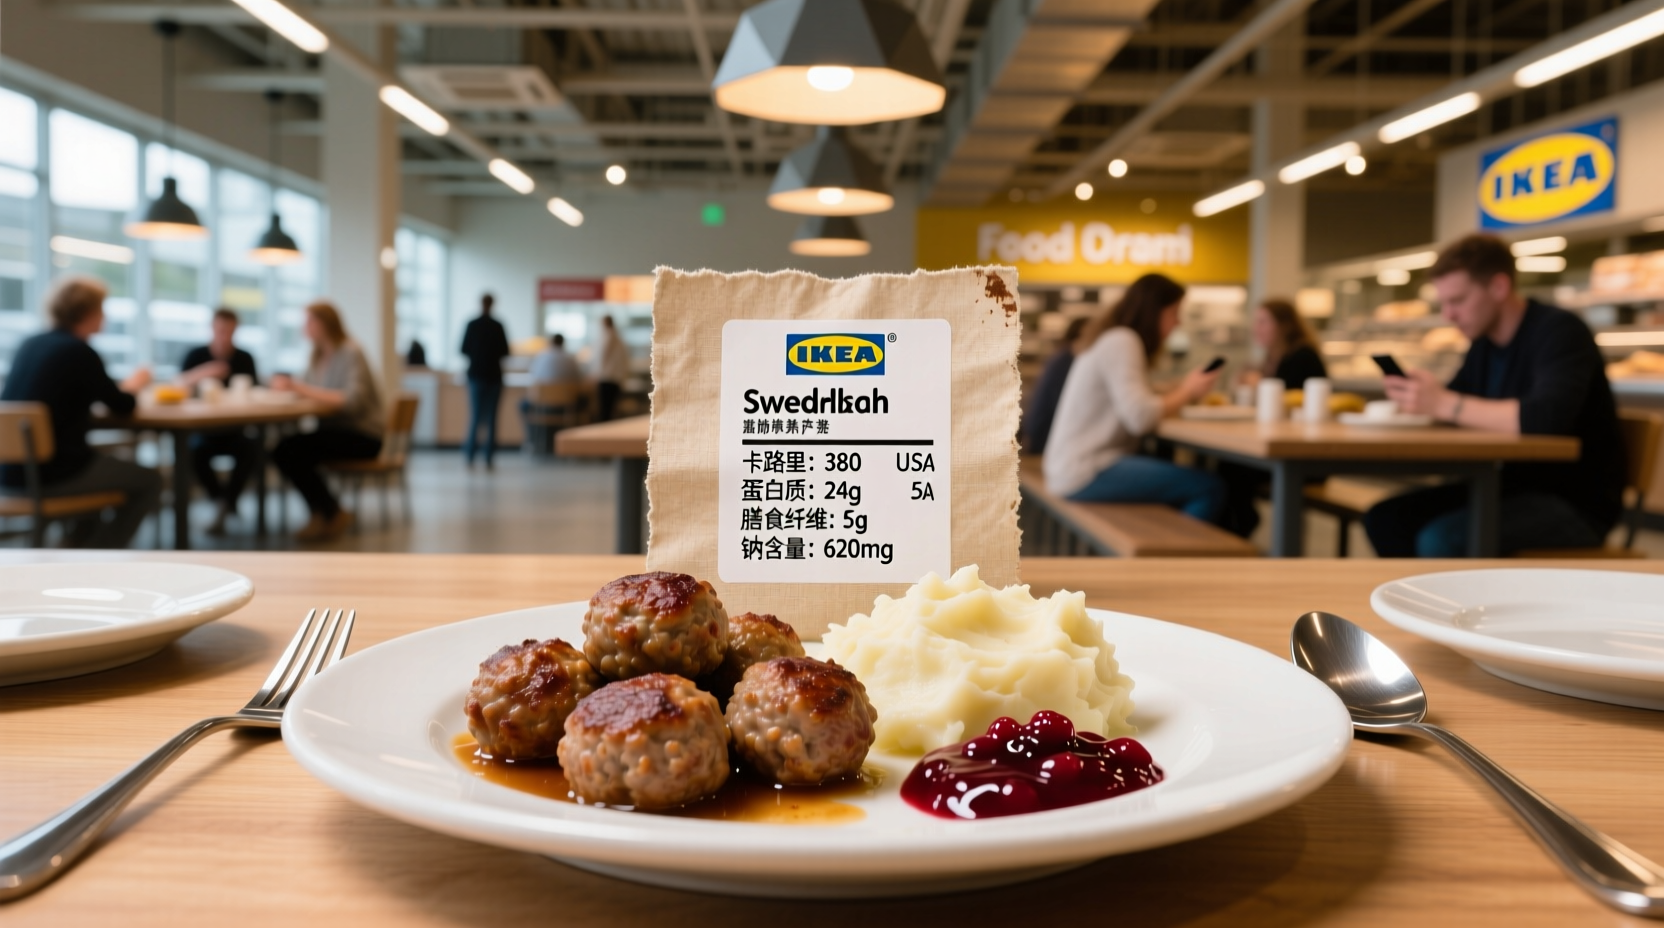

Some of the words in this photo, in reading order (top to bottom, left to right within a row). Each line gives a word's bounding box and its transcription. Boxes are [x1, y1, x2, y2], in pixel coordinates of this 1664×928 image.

[1495, 153, 1597, 200] IKEA
[977, 221, 1075, 264] Food
[796, 345, 877, 363] IKEA
[824, 452, 862, 473] 380
[896, 452, 936, 473] USA
[823, 481, 862, 506] 24g
[910, 481, 935, 502] 5A
[842, 510, 868, 535] 5g
[823, 538, 894, 565] 620mg
